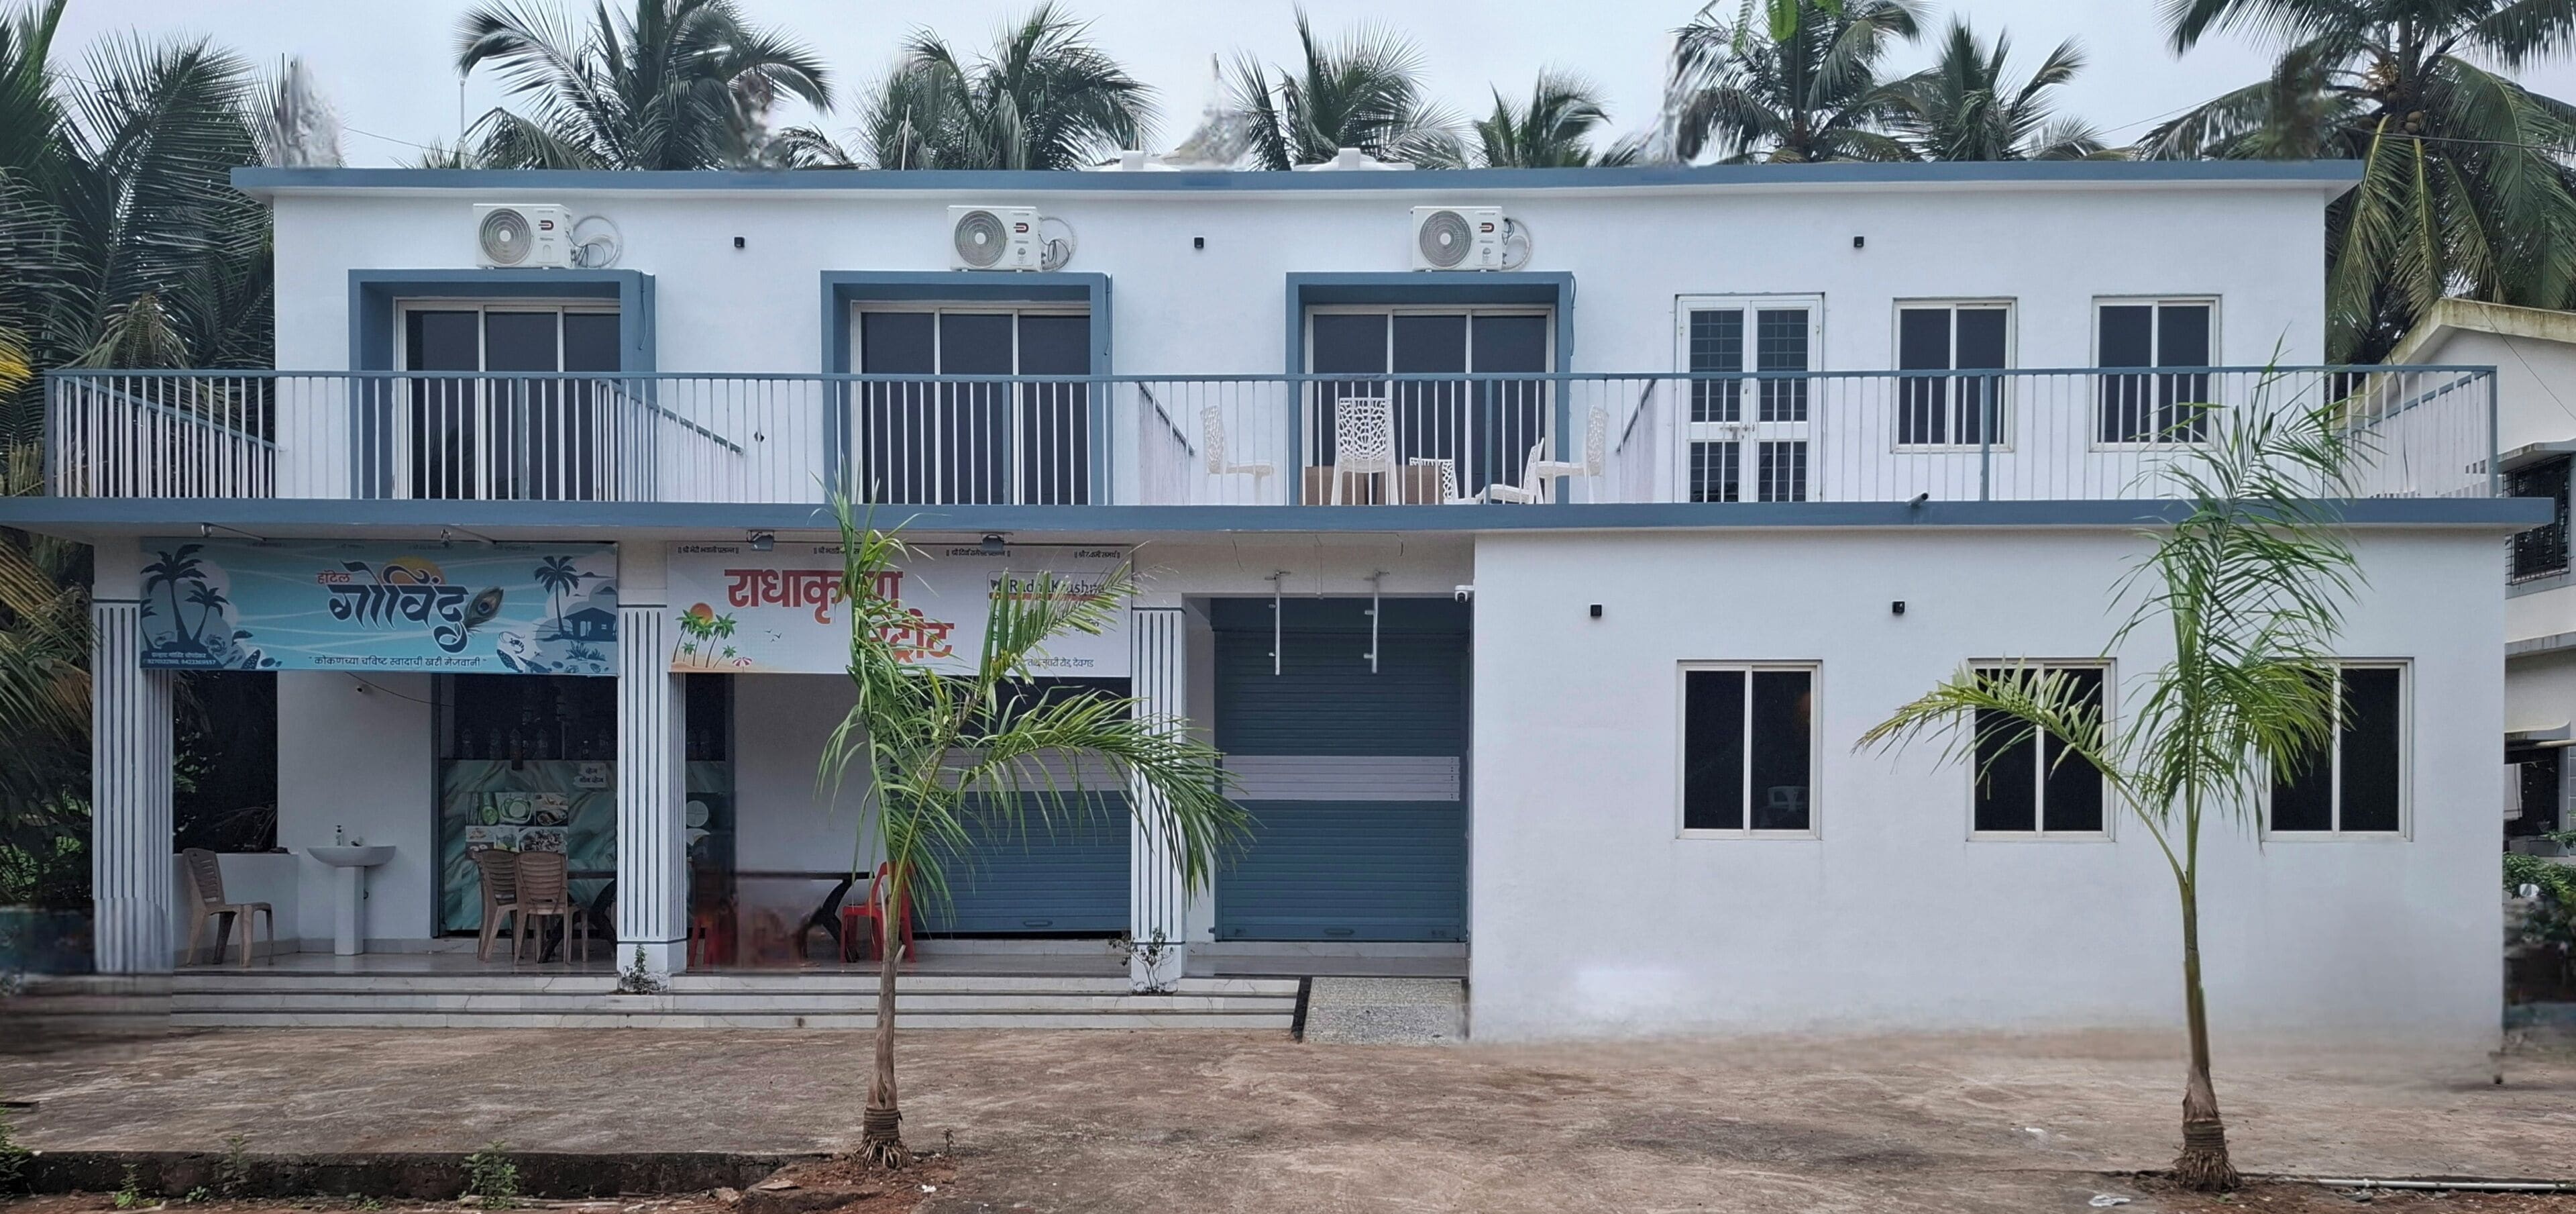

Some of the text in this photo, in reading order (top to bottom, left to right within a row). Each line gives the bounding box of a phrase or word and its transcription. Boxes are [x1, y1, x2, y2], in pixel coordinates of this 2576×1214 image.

[317, 569, 350, 585] हॉटेल
[327, 559, 470, 653] गोविंद
[315, 655, 359, 665] कोकणच्या
[361, 655, 387, 665] चविष्ट
[390, 656, 422, 666] स्वादाची
[425, 656, 442, 666] खरी
[444, 656, 480, 666] मेजवानी
[1073, 657, 1094, 668] देवगड
